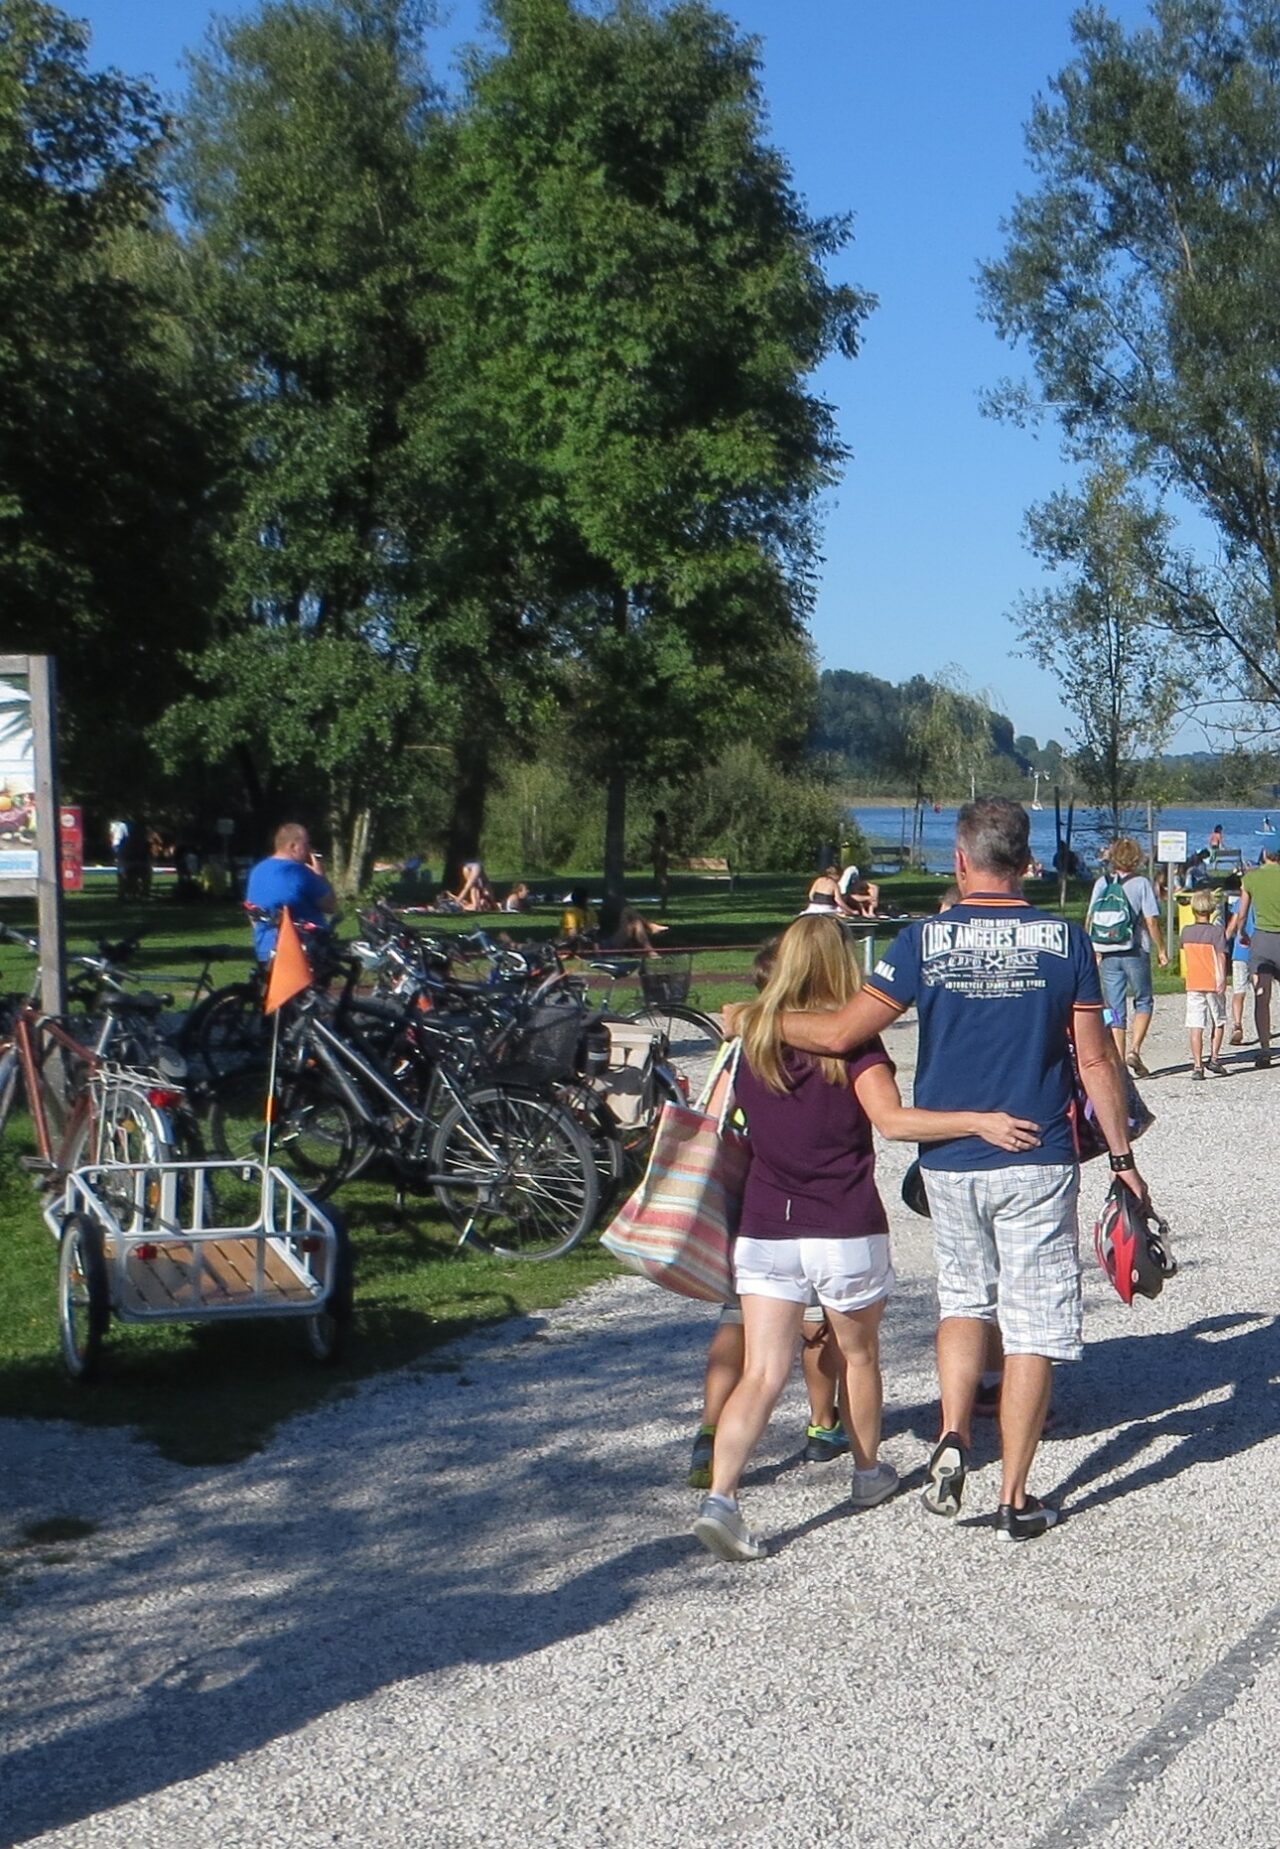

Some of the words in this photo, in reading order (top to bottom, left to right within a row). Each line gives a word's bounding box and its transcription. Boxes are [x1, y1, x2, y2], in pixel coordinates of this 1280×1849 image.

[928, 923, 953, 956] LOS
[955, 926, 1013, 949] ANGELES
[1015, 923, 1064, 952] RIDERS
